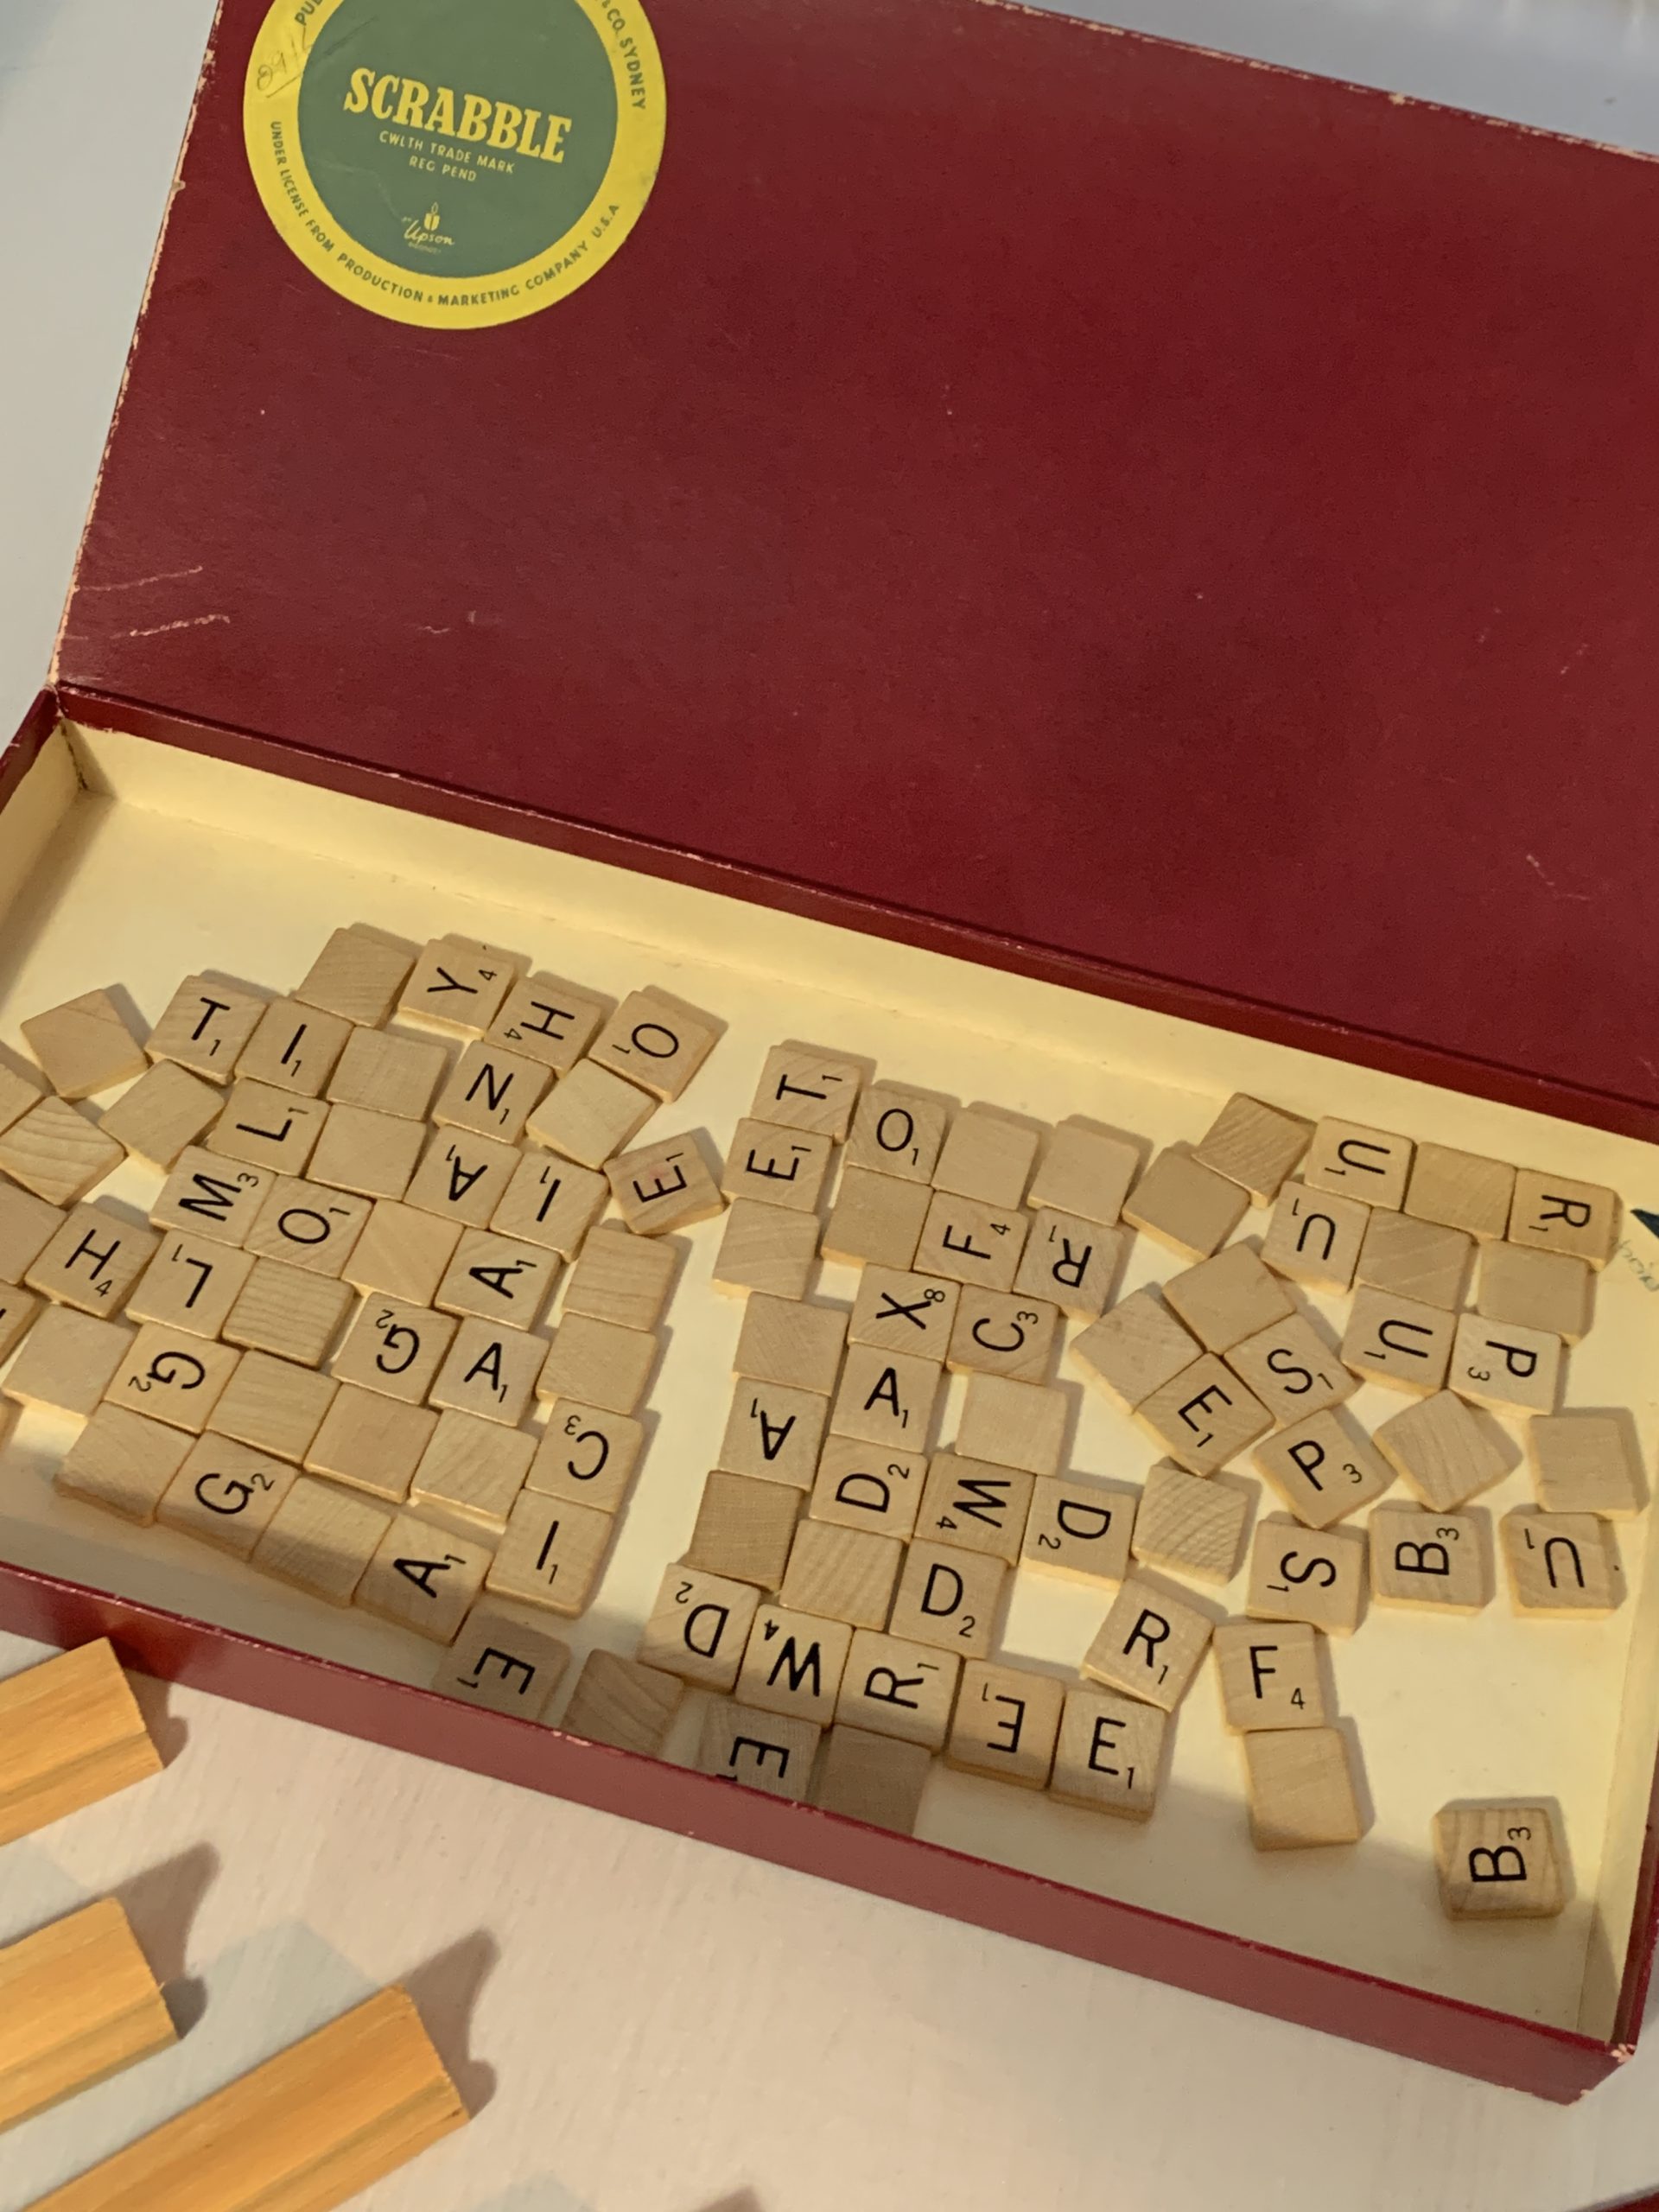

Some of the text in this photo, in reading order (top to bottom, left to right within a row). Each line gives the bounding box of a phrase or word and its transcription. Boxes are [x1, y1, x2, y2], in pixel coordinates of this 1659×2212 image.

[619, 36, 646, 110] SYDNEY
[344, 67, 572, 163] SCRABBLE
[378, 130, 516, 174] CWLTH TRADE MARK
[409, 155, 477, 182] REG PEND
[270, 121, 288, 166] UNDER
[279, 168, 310, 217] LICENSE
[305, 219, 335, 252] FROM
[336, 252, 423, 303] PRODUCTION
[437, 284, 521, 307] MARKETING
[524, 240, 588, 290] COMPANY
[404, 219, 456, 246] Upson
